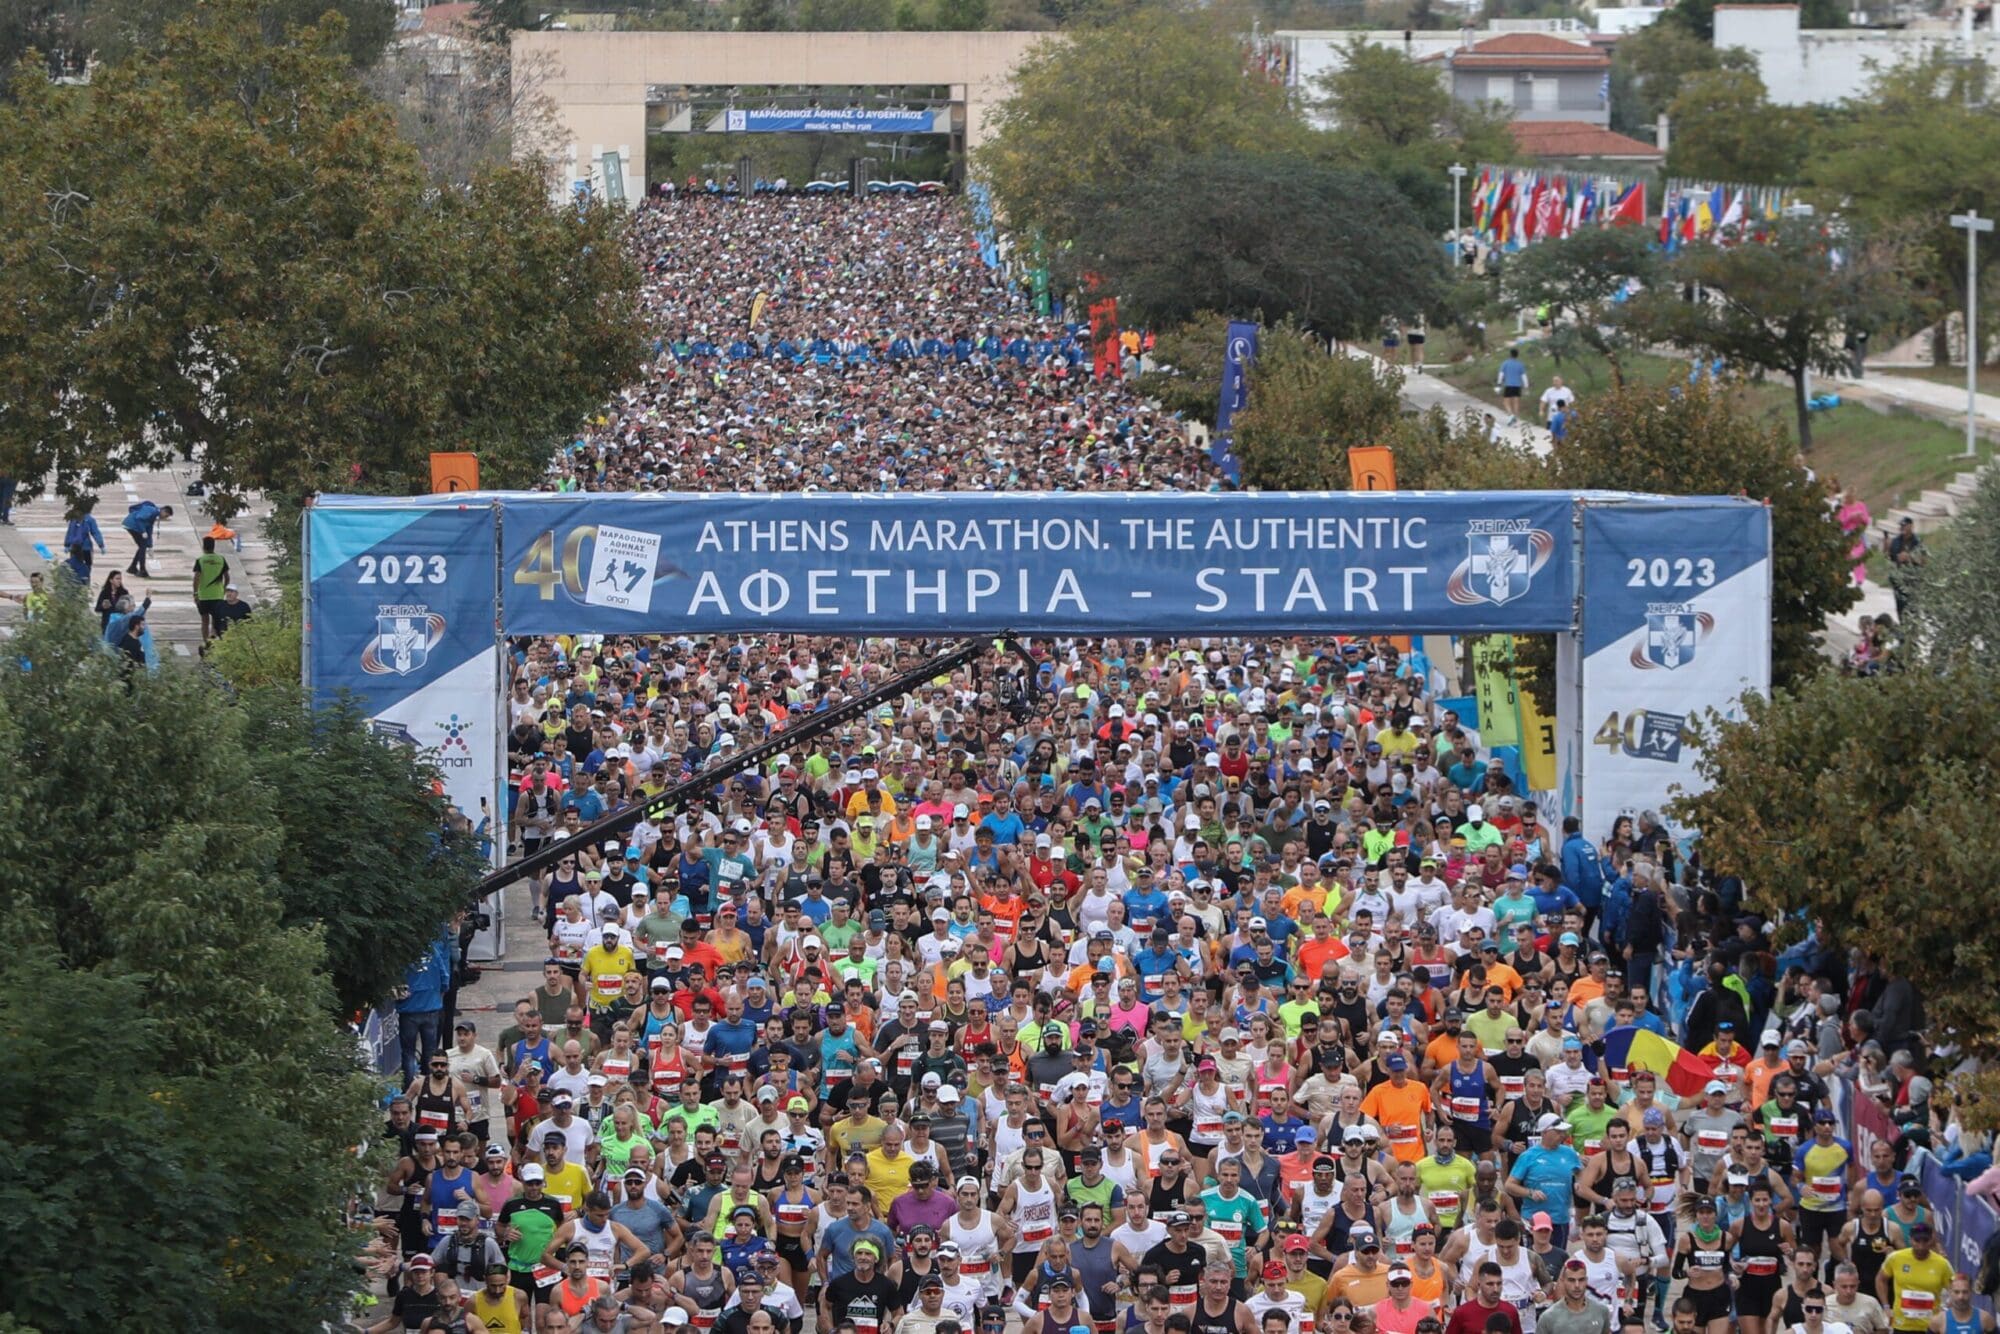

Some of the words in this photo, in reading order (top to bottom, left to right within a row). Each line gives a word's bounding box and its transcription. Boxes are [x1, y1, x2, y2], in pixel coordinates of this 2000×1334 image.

[750, 110, 812, 119] ΜΑΡΑΘΩΝΙΟΣ
[865, 111, 923, 120] ΑΥΘΕΝΤΙΚΟΣ
[804, 122, 828, 130] music
[842, 122, 855, 130] the
[695, 520, 849, 552] ATHENS
[870, 518, 1110, 551] MARATHON.
[1121, 518, 1195, 550] THE
[1204, 517, 1428, 550] AUTHENTIC
[1468, 519, 1531, 533] ΣΕΓΑΣ
[600, 530, 658, 546] ΜΑΡΑΘΩΝΙΟΣ
[609, 540, 646, 552] ΑΘΗΝΑΣ
[357, 555, 447, 584] 2023
[1626, 558, 1715, 587] 2023
[687, 569, 1090, 616] ΑΦΕΤΗΡΙΑ
[1195, 566, 1428, 612] START
[378, 605, 427, 616] ΣΕΓΑΣ
[1594, 708, 1648, 757] 40
